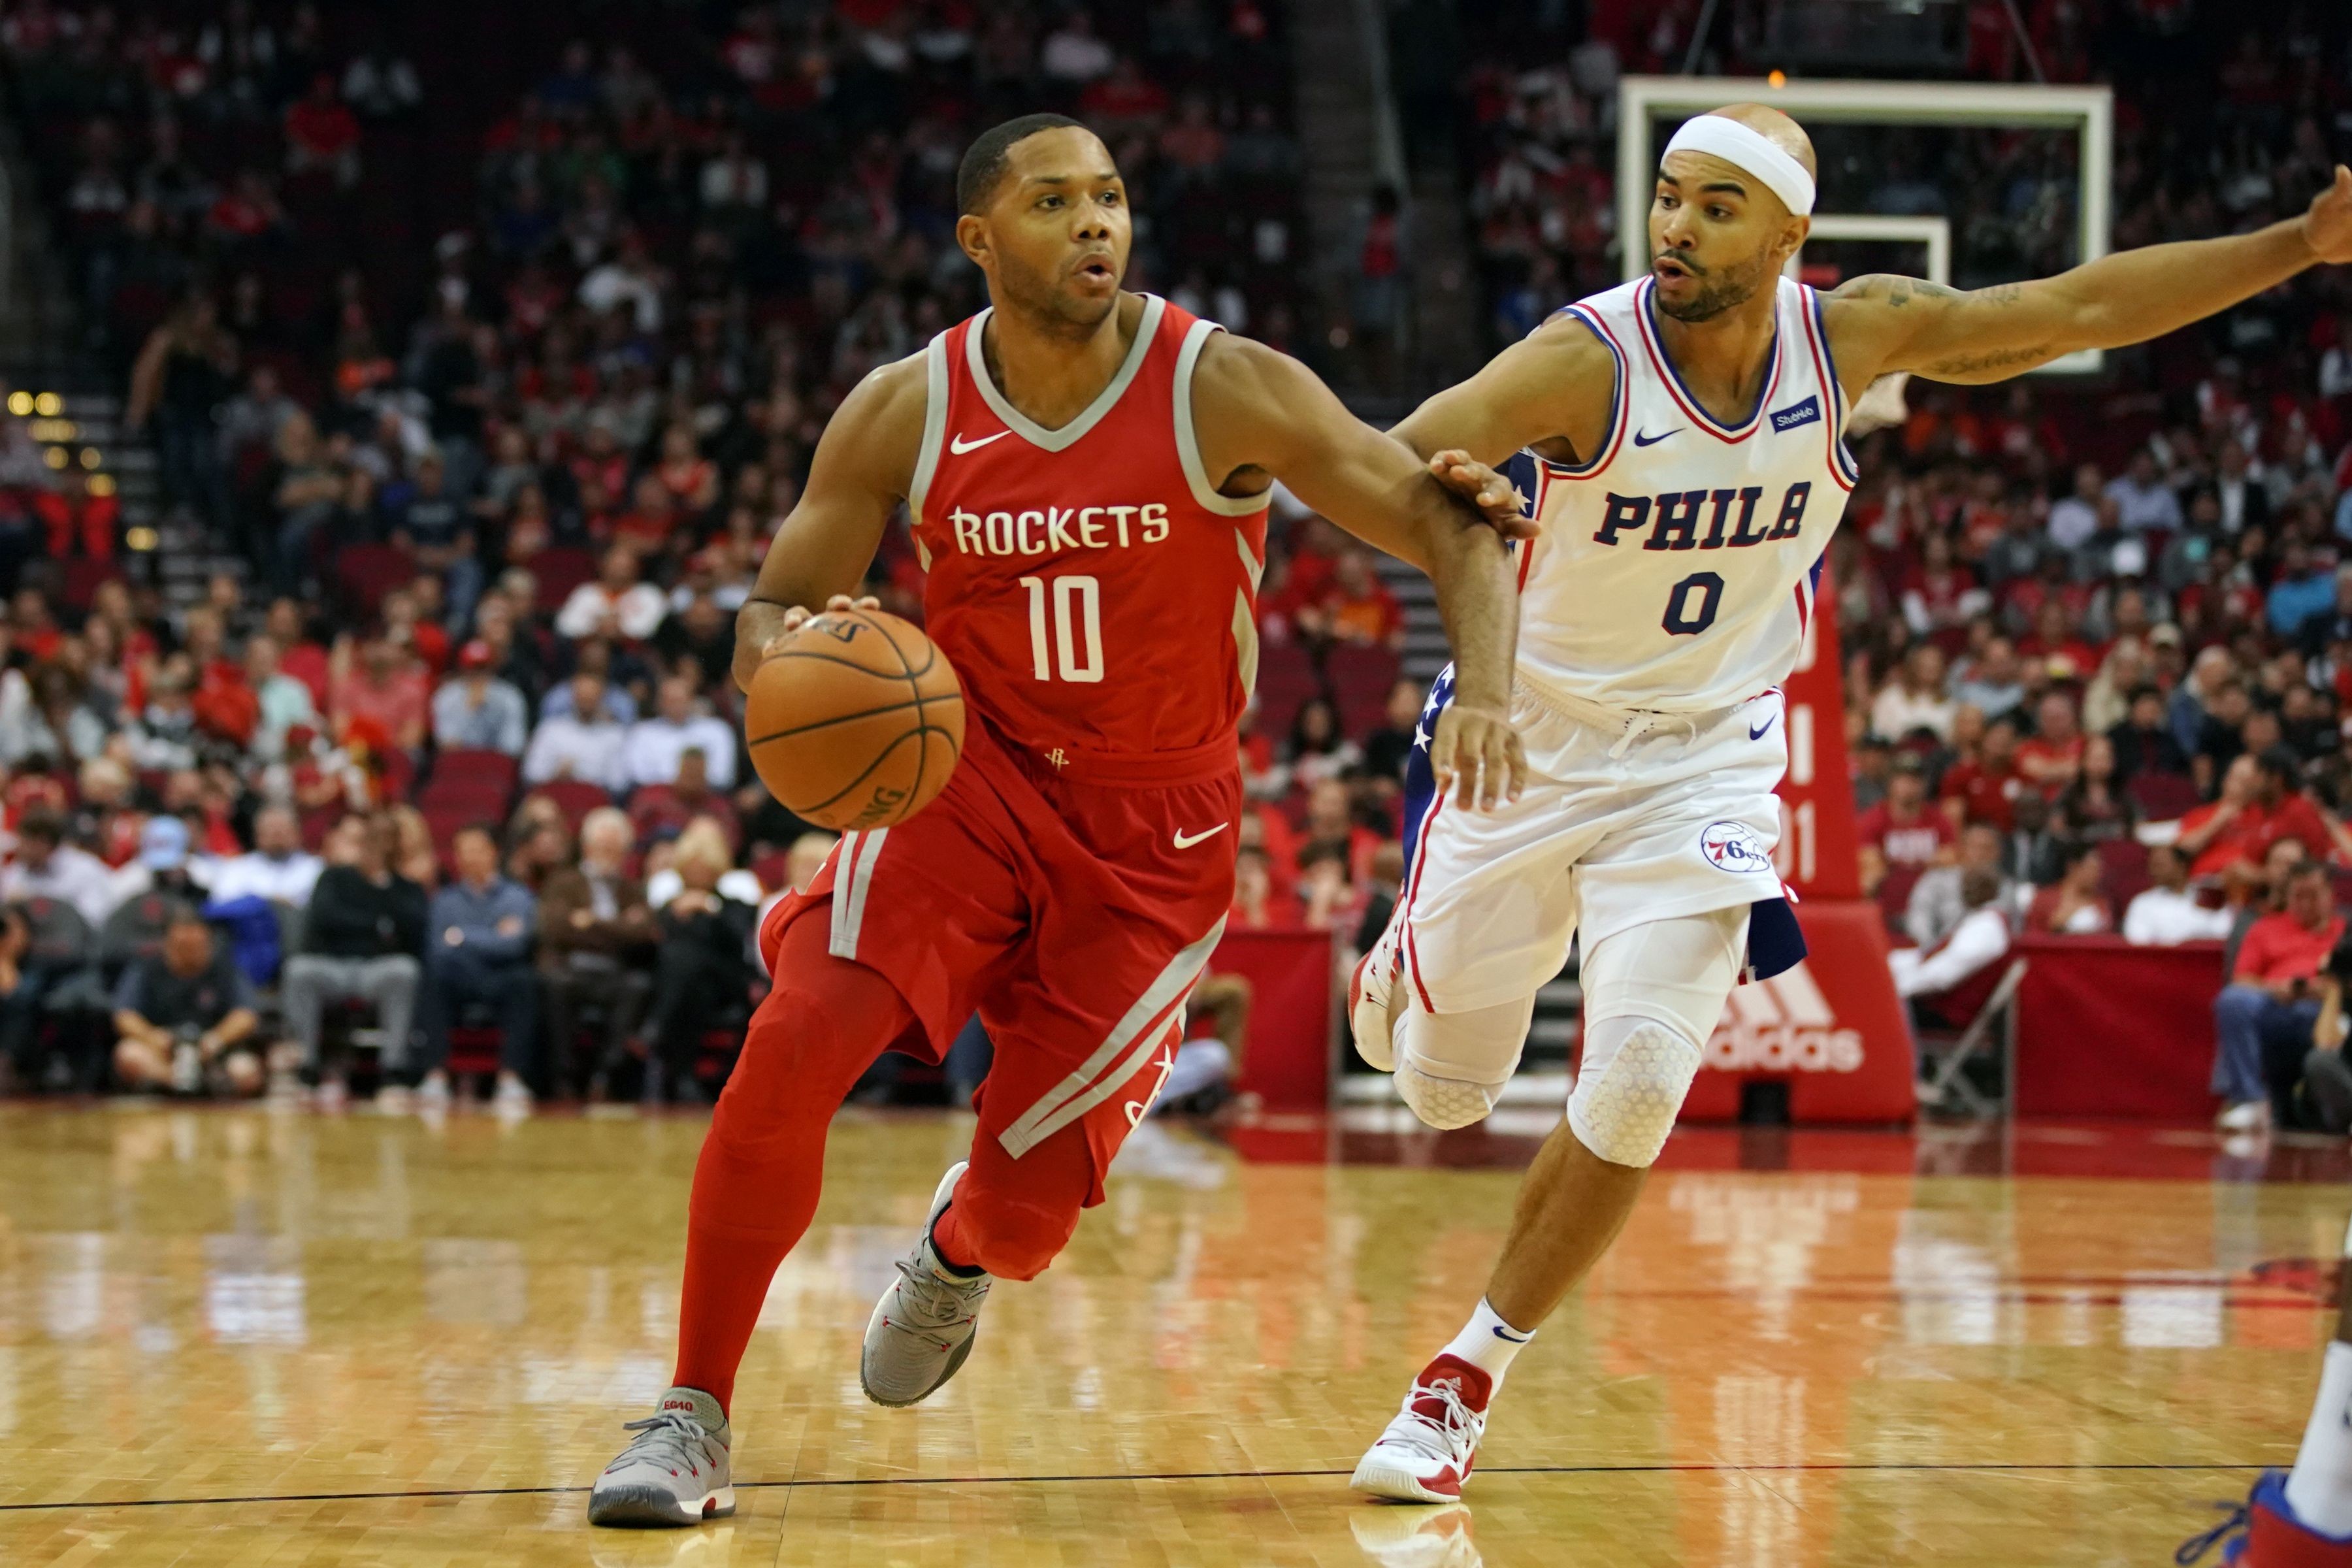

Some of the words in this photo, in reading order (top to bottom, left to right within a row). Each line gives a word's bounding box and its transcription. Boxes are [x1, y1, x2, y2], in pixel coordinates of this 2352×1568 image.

[1776, 406, 1814, 427] StubHub
[947, 503, 1169, 556] ROCKETS
[1592, 481, 1812, 551] PHILA
[1019, 575, 1104, 683] 10
[1661, 572, 1725, 636] 0
[1699, 1021, 1864, 1073] didas
[664, 1400, 693, 1412] EG10
